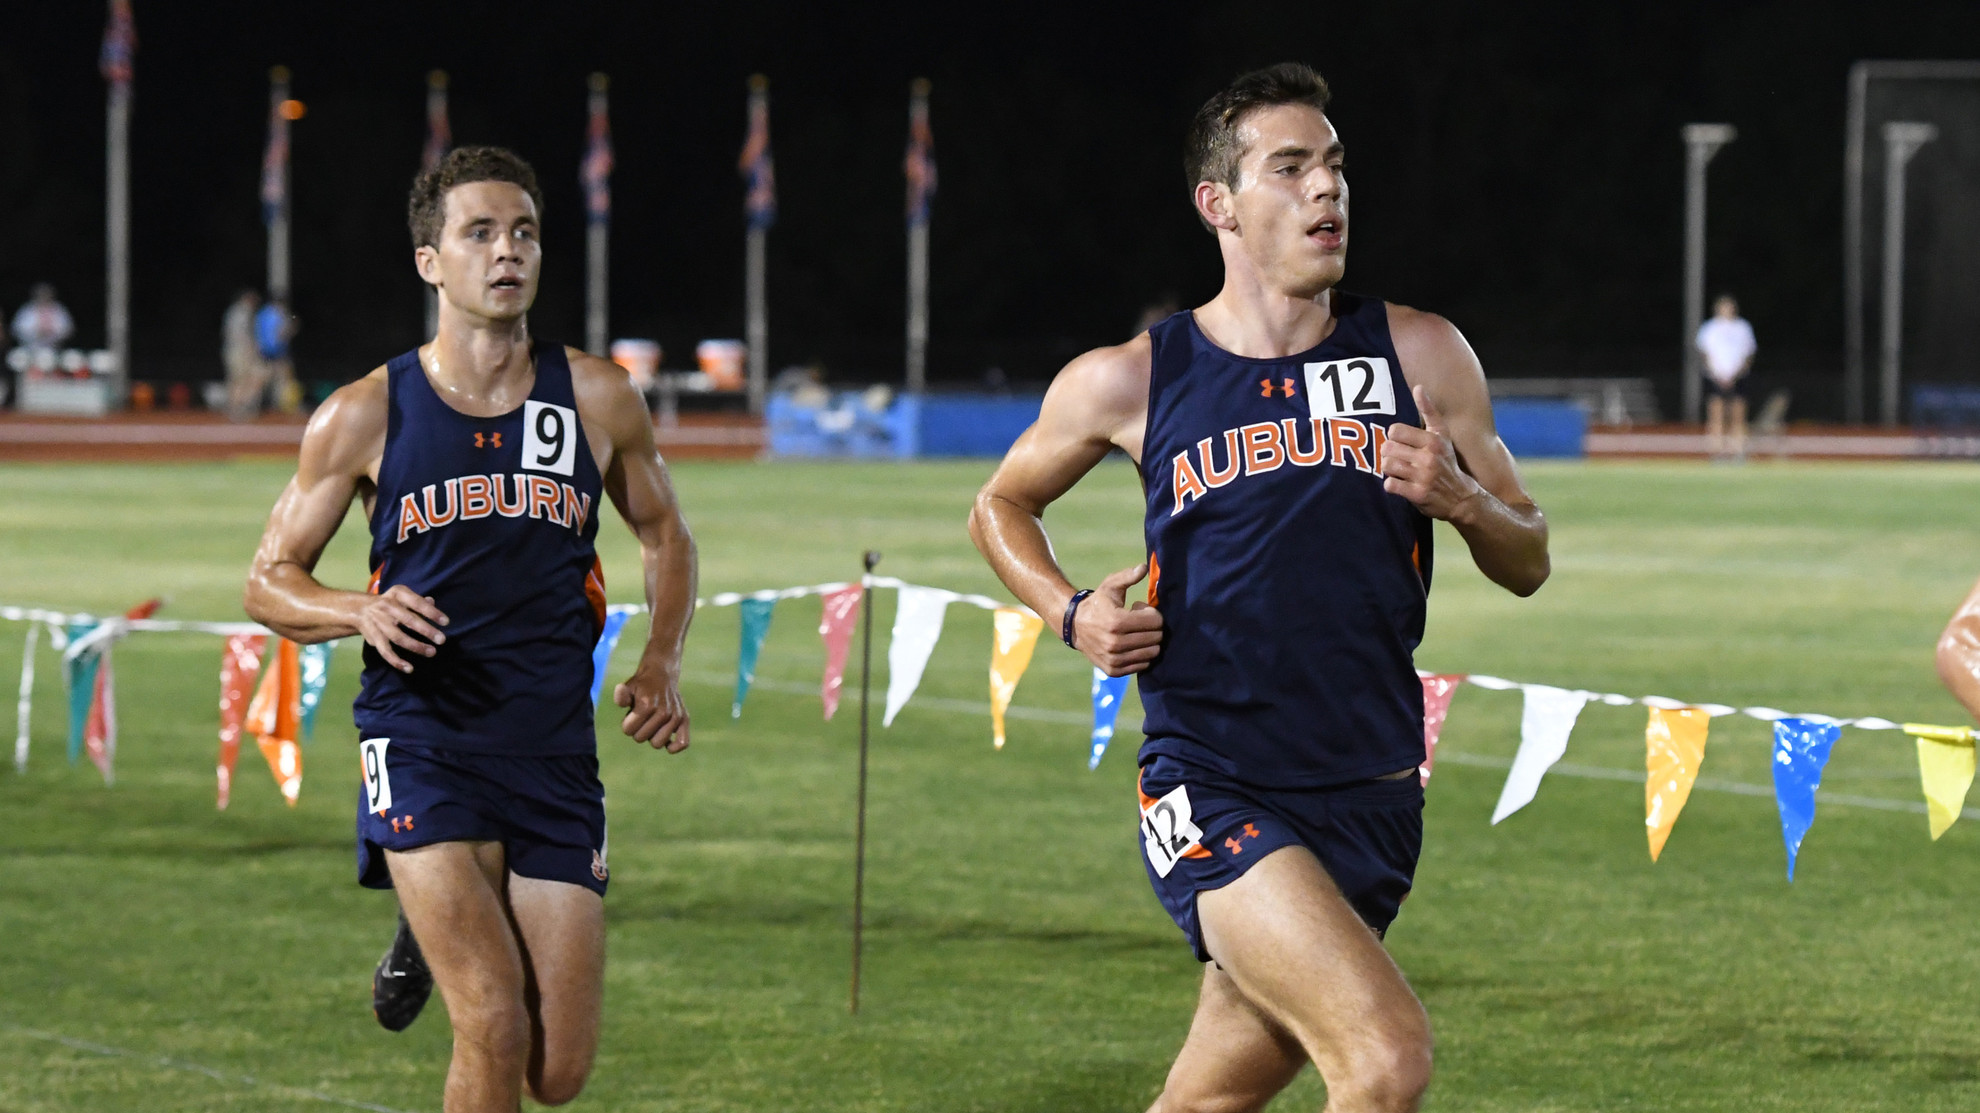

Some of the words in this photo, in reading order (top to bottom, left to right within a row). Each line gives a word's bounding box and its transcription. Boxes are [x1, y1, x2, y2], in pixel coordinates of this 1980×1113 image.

[1320, 360, 1381, 412] 12
[535, 407, 564, 466] 9
[397, 474, 590, 543] AUBURN
[366, 743, 380, 807] 9
[1146, 800, 1190, 862] 12
